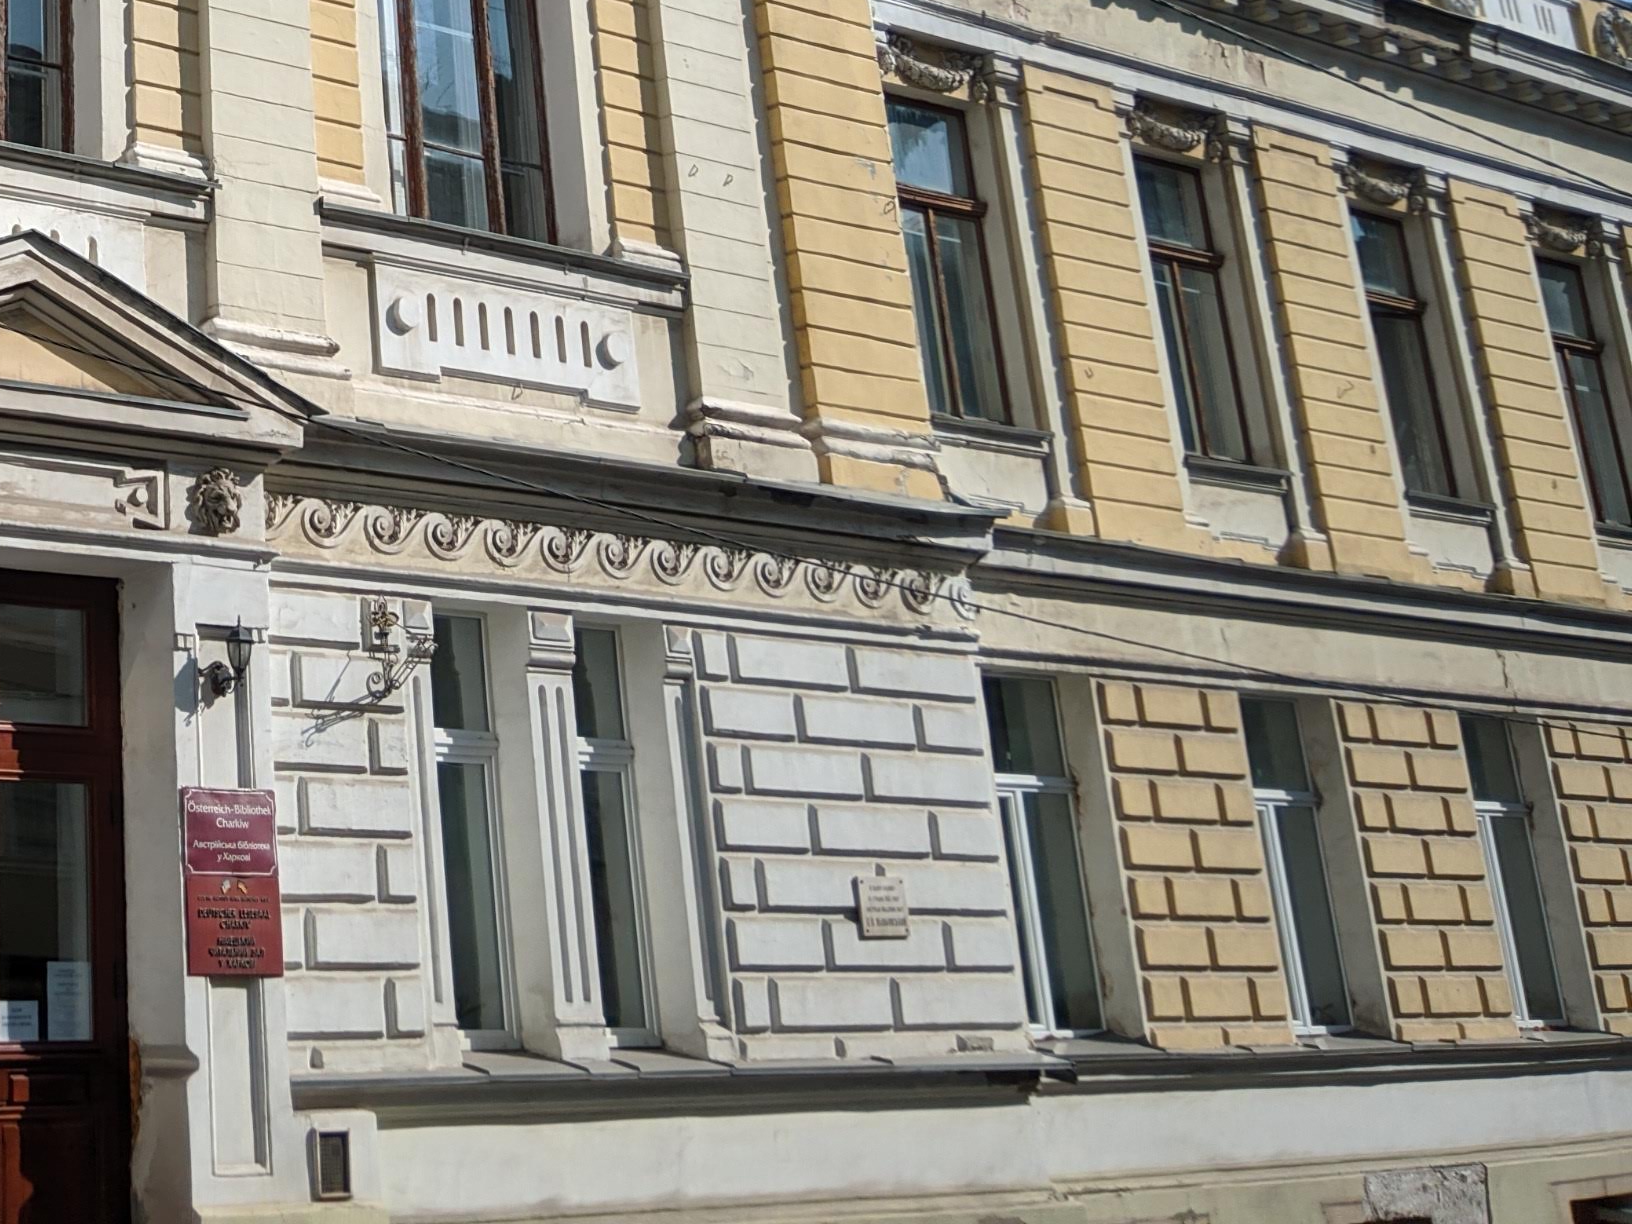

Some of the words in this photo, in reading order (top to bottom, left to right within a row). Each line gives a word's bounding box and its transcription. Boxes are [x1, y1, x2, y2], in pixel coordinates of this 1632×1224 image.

[188, 800, 272, 815] Österreich-Bibliothek
[216, 817, 249, 829] Charkiw
[192, 839, 236, 851] Австрійська
[237, 840, 270, 850] бібліотека
[223, 852, 251, 863] Харкові
